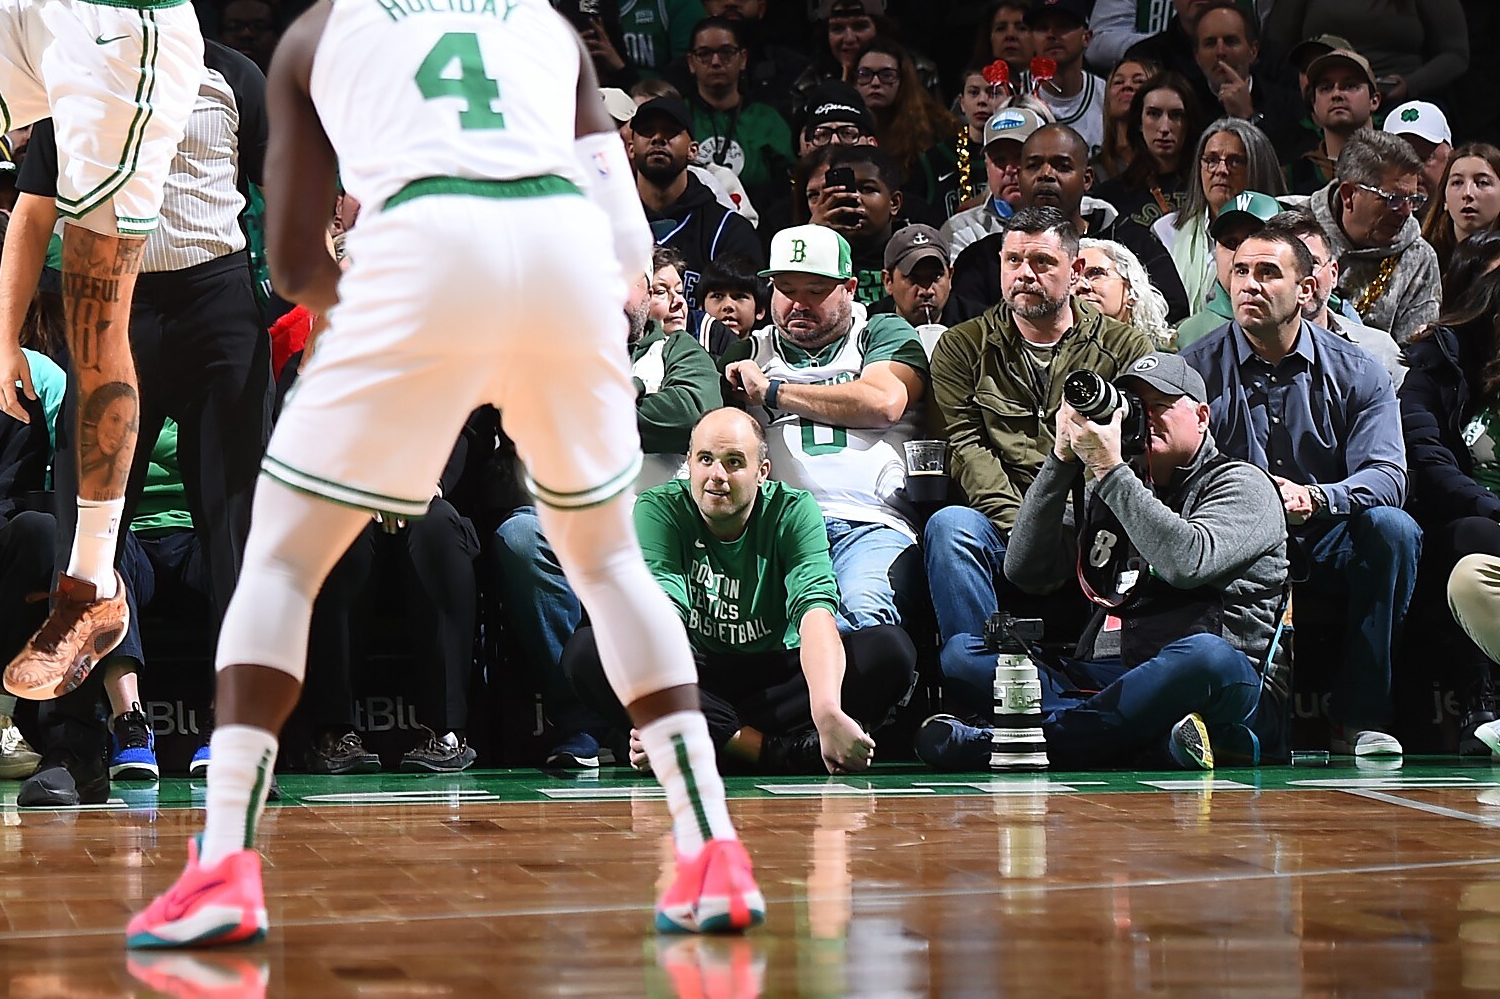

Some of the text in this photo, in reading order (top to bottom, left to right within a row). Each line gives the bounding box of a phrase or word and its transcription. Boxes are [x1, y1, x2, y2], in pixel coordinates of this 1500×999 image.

[414, 32, 506, 130] 4
[1235, 193, 1254, 212] W
[789, 239, 808, 263] B
[1089, 528, 1118, 568] 8
